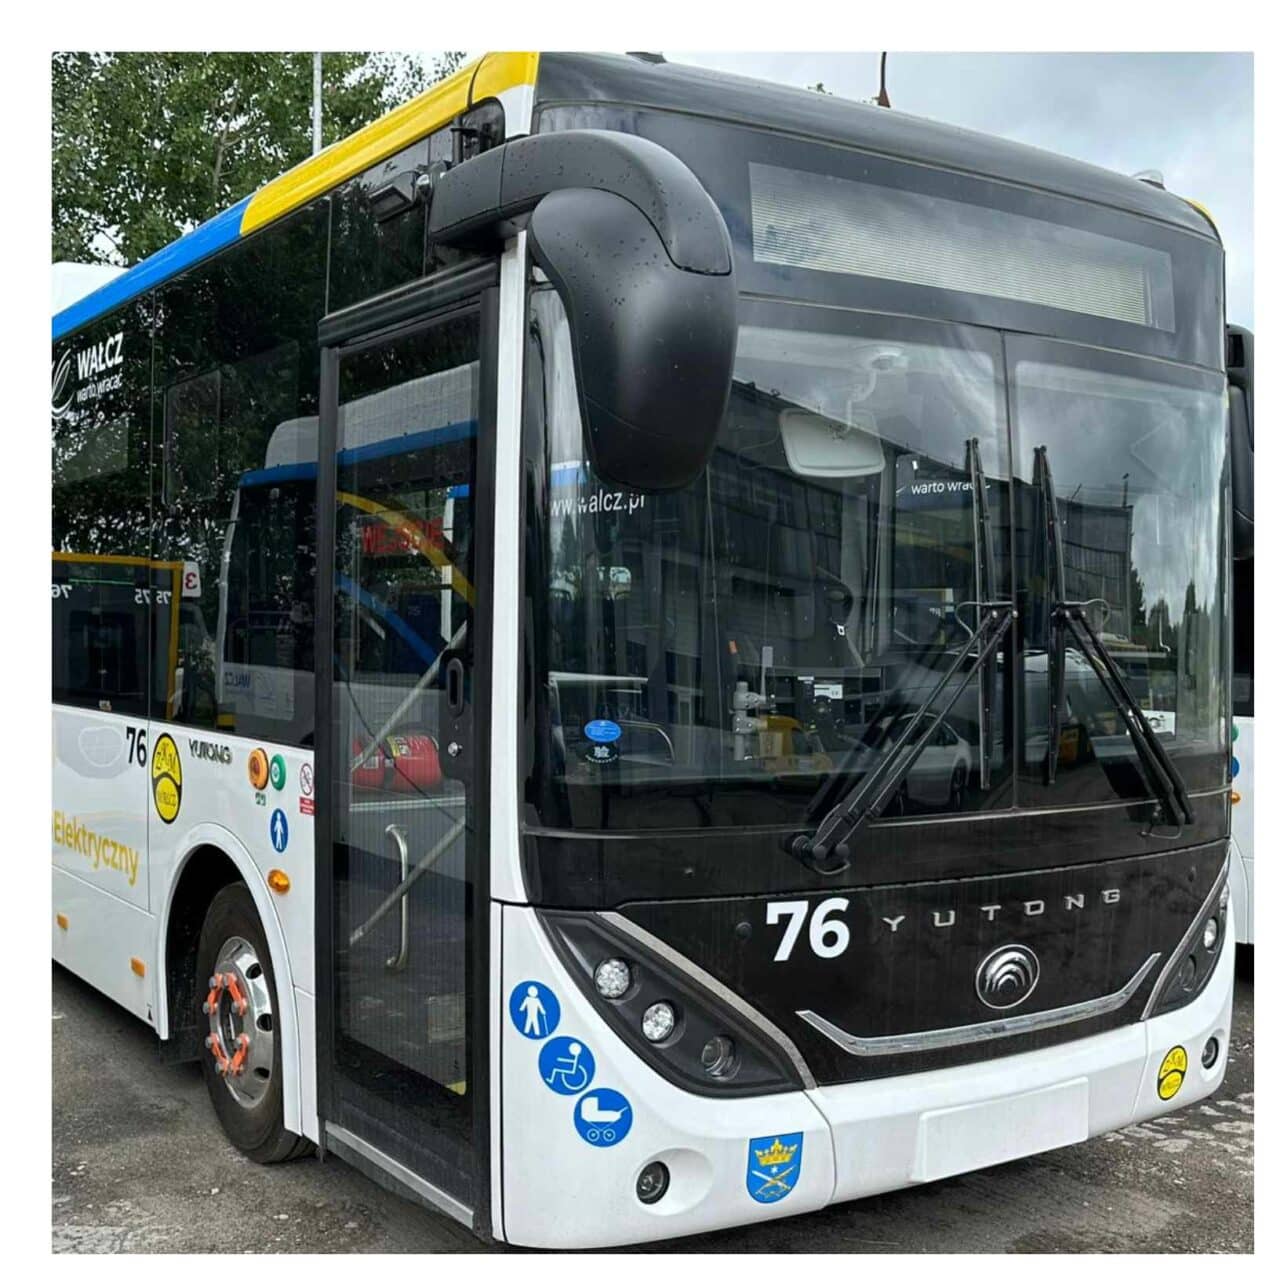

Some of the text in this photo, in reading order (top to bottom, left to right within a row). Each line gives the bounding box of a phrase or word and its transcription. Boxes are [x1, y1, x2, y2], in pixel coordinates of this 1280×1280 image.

[77, 332, 123, 380] WAŁCZ
[911, 482, 944, 495] warto
[126, 726, 147, 767] 76
[188, 738, 233, 765] YUTONG
[53, 810, 139, 887] Elektryczny
[766, 897, 850, 962] 76
[883, 888, 1120, 931] YUTONG
